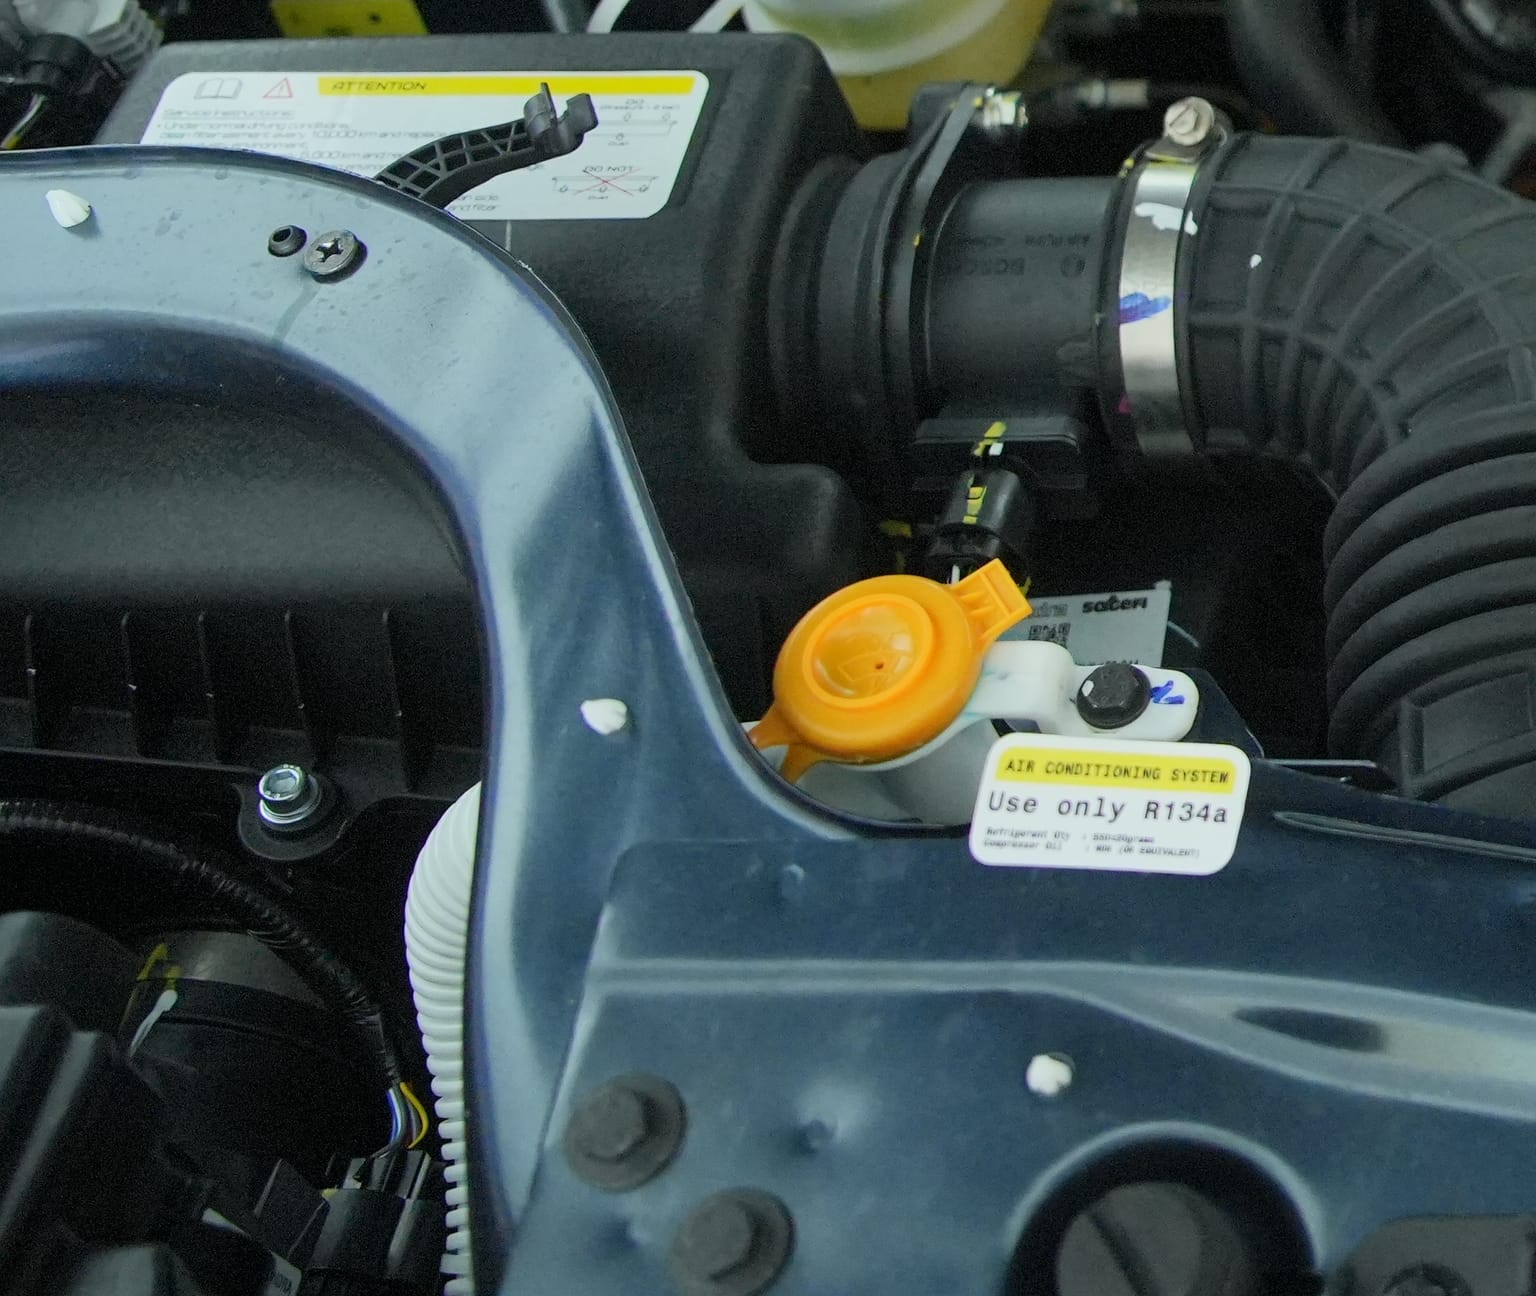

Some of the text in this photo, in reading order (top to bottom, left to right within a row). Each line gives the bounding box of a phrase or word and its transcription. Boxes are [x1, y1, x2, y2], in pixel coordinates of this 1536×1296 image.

[332, 80, 426, 91] ATTENTION
[1005, 759, 1229, 784] AIR CONDITIONING SYSTEM
[988, 791, 1228, 823] Use only R134a
